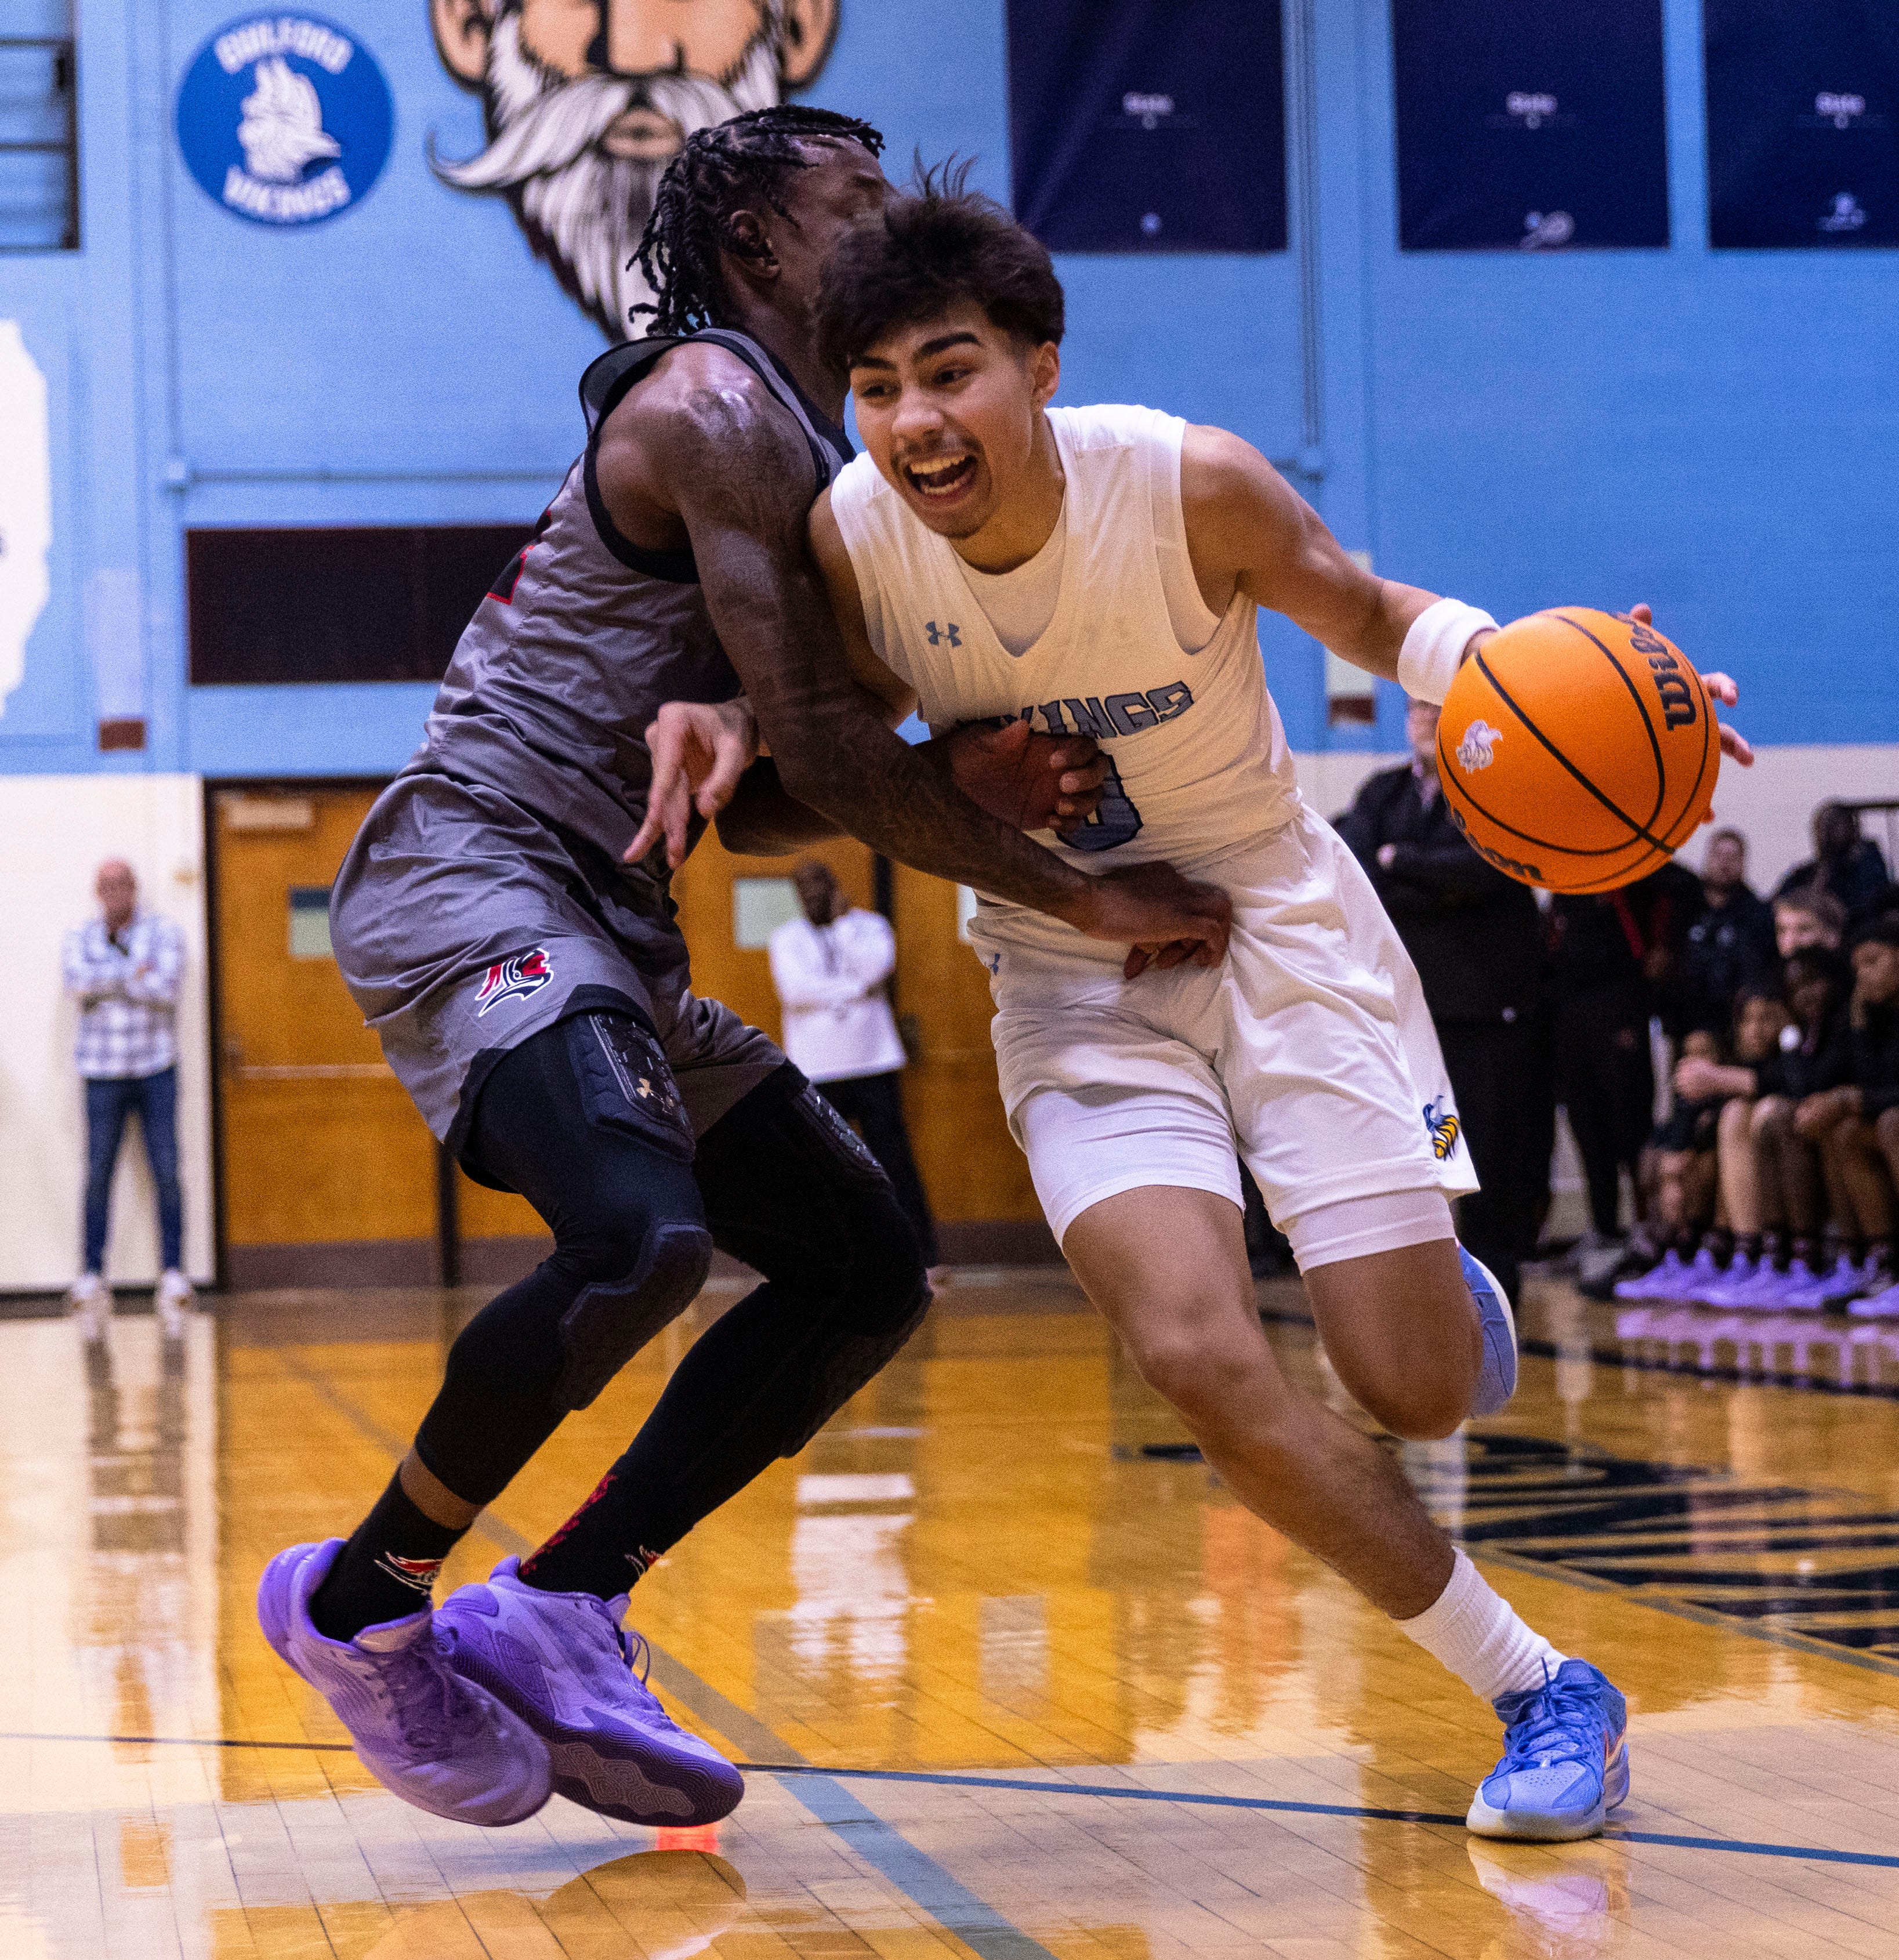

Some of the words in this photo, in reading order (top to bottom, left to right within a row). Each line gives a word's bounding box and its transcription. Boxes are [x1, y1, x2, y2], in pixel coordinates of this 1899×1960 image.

[213, 17, 354, 74] GUILFORD
[222, 164, 351, 222] VIKINGS
[958, 680, 1195, 740] INGS
